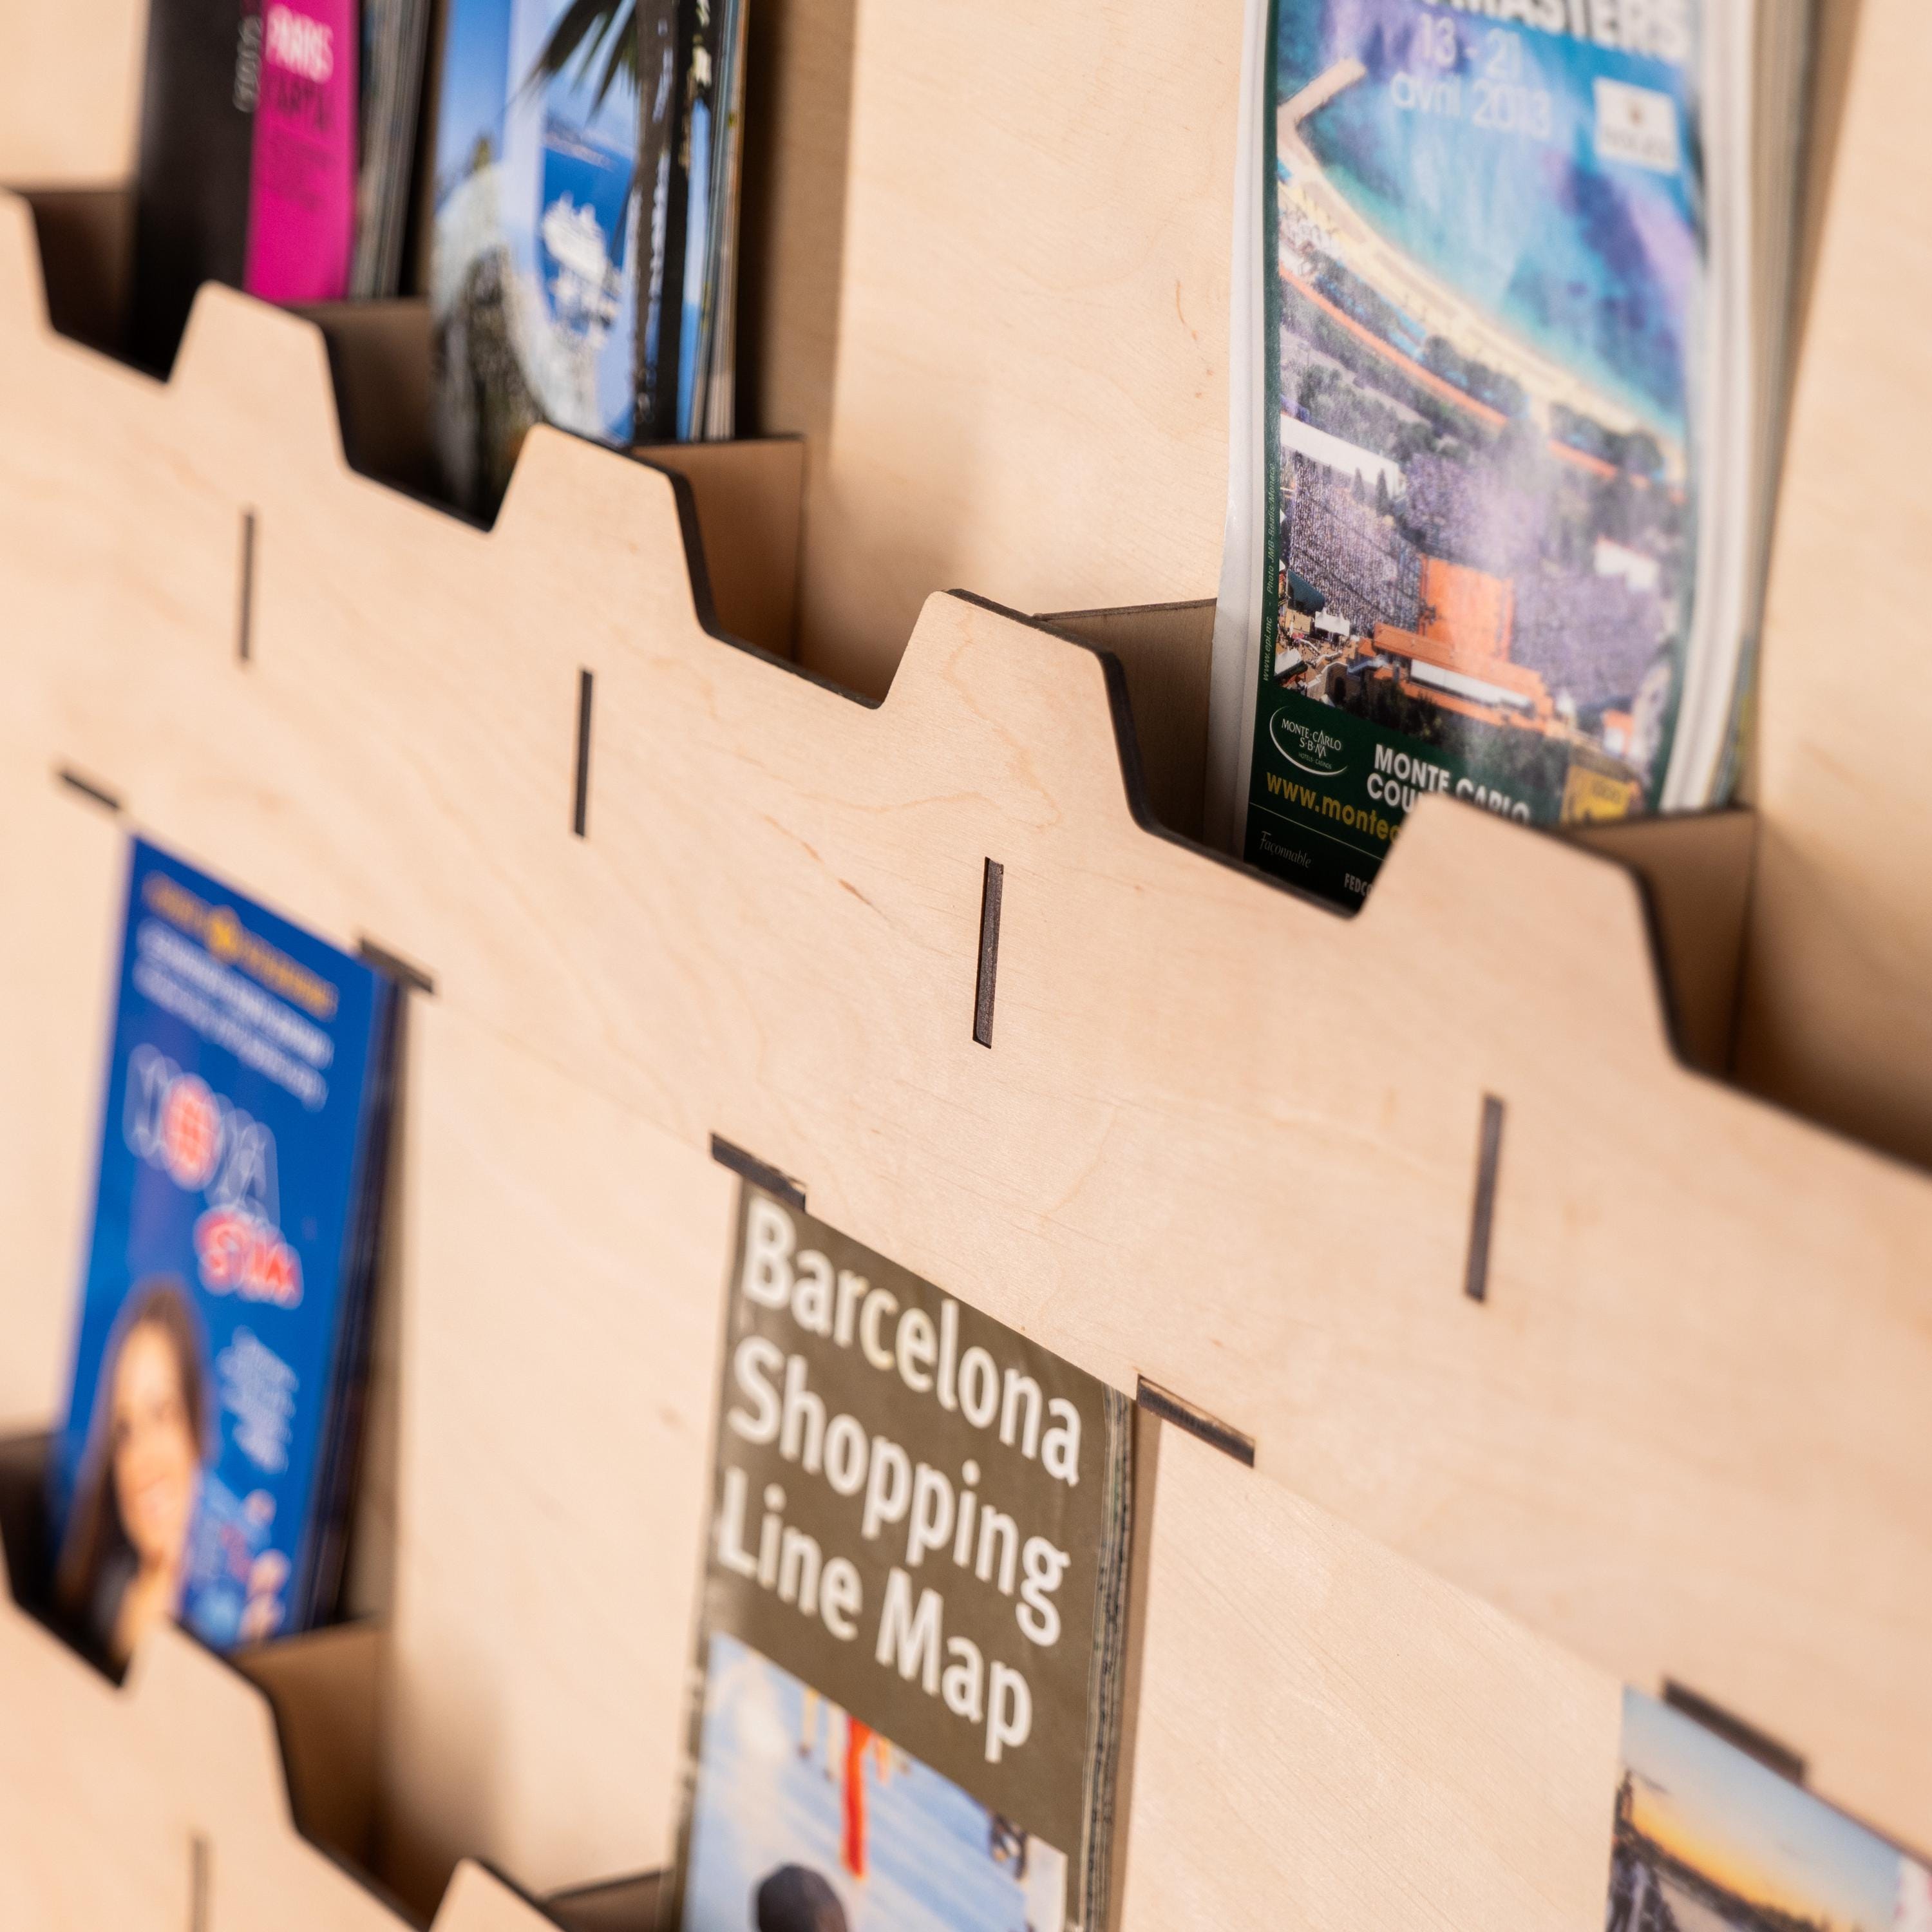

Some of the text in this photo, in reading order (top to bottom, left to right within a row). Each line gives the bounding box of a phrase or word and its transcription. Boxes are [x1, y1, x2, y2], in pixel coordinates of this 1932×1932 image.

[1420, 13, 1456, 66] 13
[1486, 28, 1522, 80] 21
[1390, 71, 1551, 140] avril 2013
[1262, 616, 1273, 681] www.epi.mc
[1374, 743, 1450, 793] MONTE
[1260, 830, 1312, 868] Façonnable
[741, 1194, 1083, 1486] Barcelona
[727, 1334, 1070, 1647] Shopping
[715, 1466, 1032, 1765] Line Map
